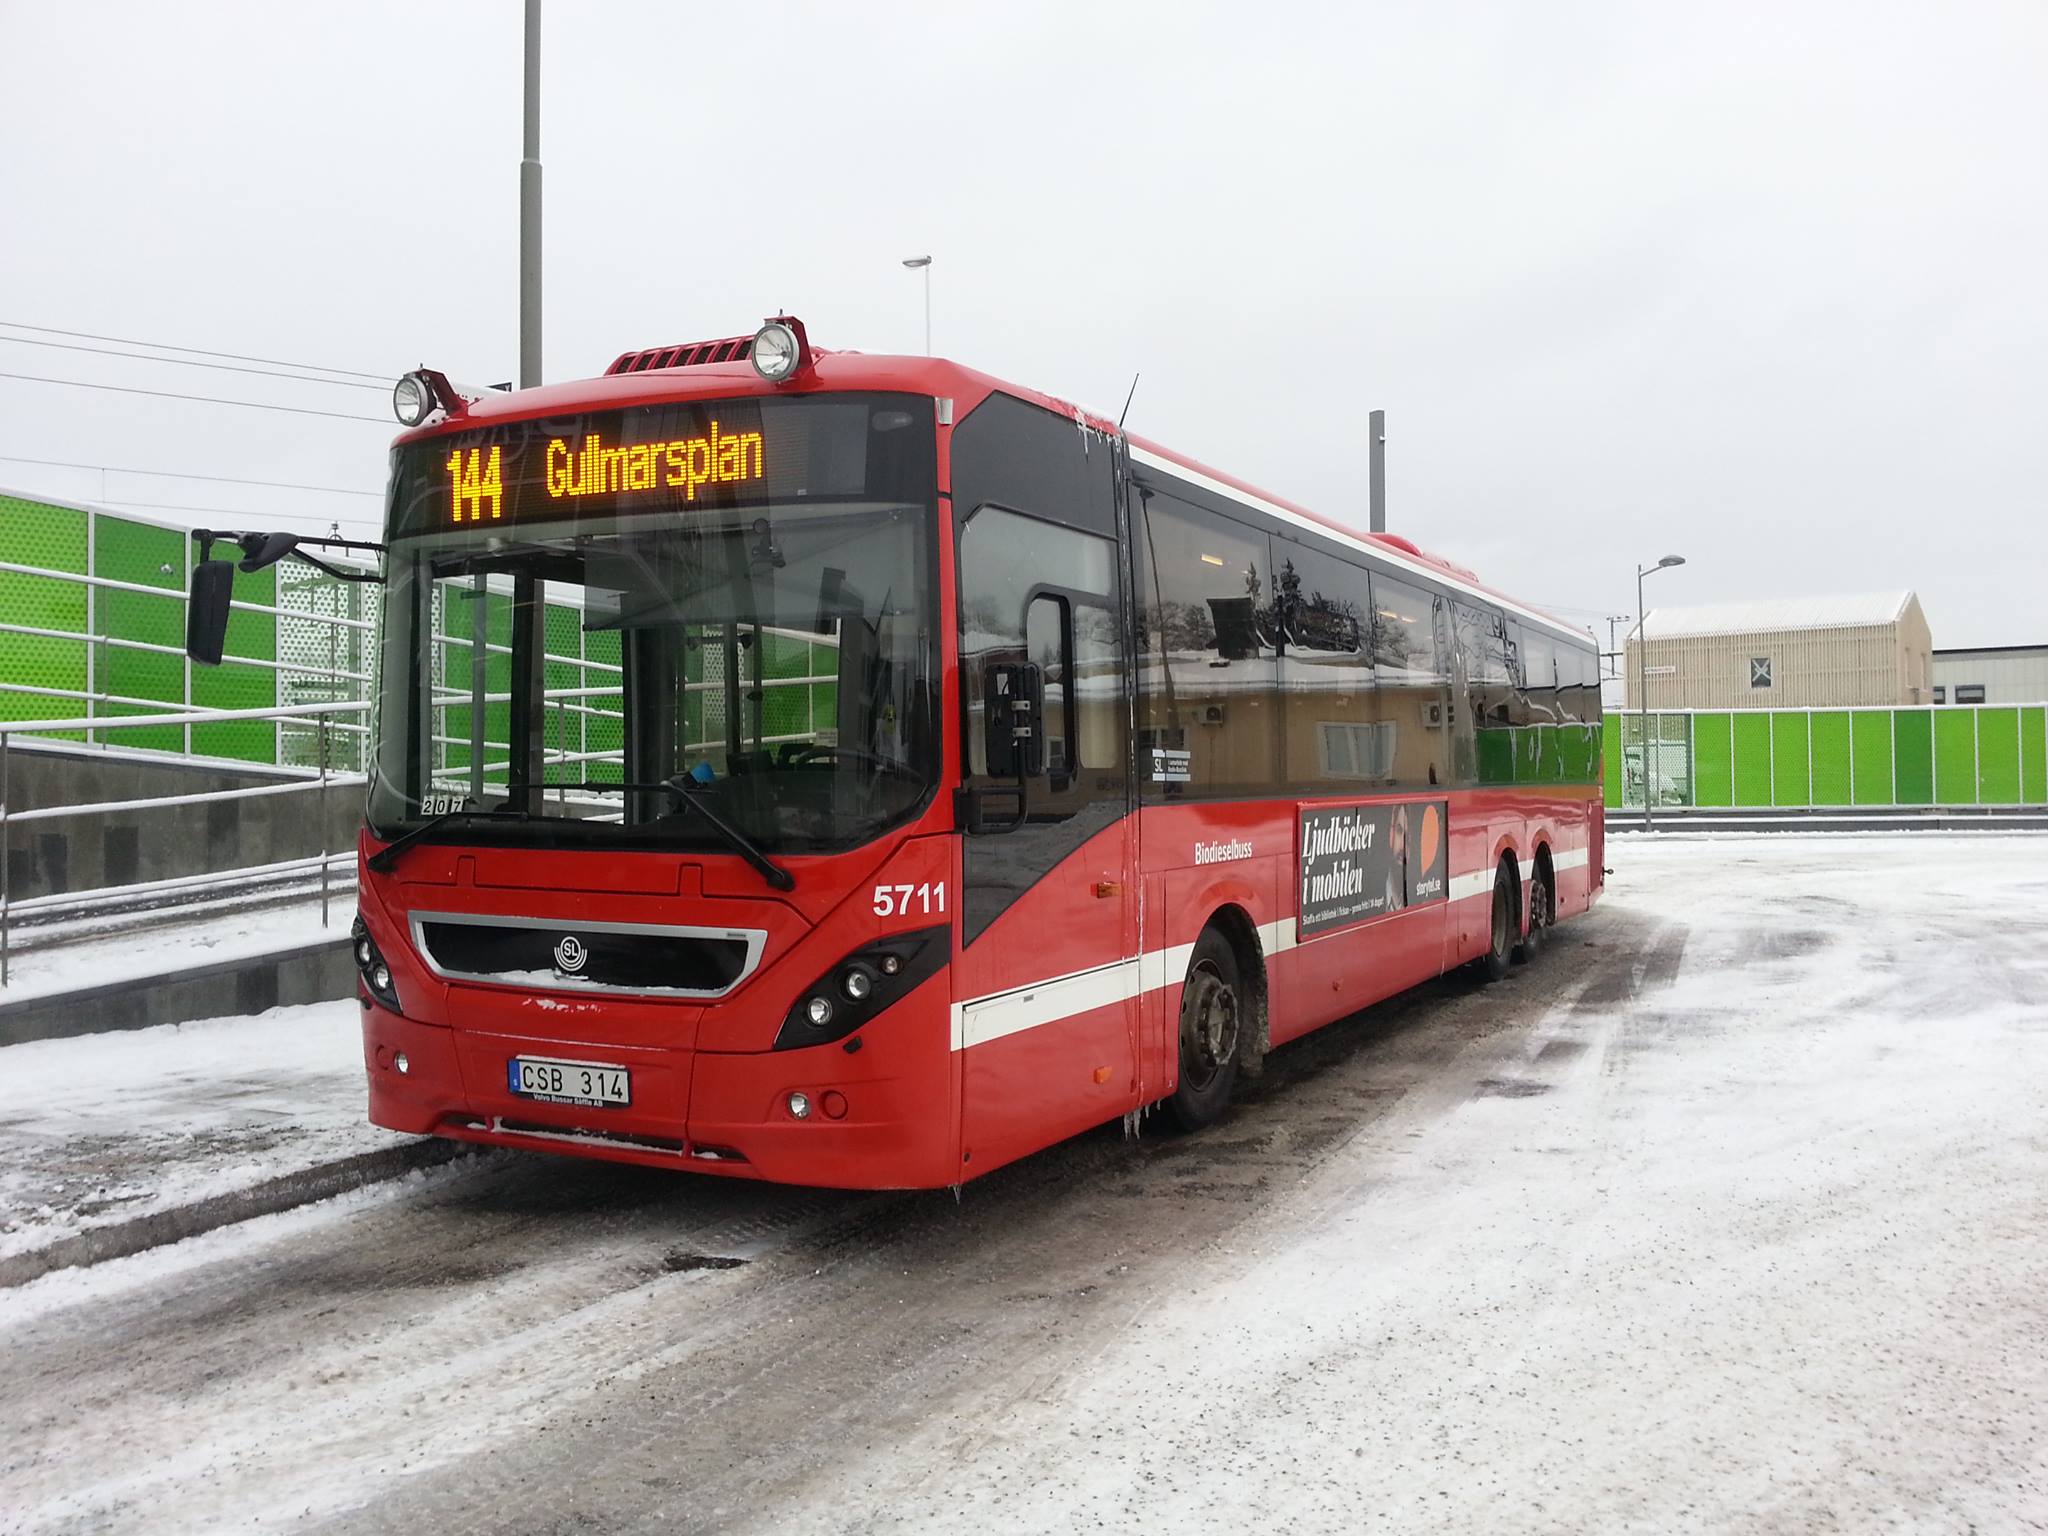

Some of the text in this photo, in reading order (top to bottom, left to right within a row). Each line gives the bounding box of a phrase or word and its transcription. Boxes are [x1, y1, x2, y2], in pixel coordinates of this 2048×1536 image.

[446, 420, 763, 522] 144 Gullmarsplan
[1154, 758, 1164, 772] SL
[1195, 838, 1253, 865] Biodieselbuss
[1302, 814, 1376, 865] Ljudböcker
[1303, 859, 1363, 905] i mobilen
[1416, 877, 1441, 897] storytel.se
[872, 881, 945, 916] 5711
[563, 942, 578, 957] SL
[522, 1065, 623, 1099] CSB 314
[533, 1092, 550, 1102] Volvo
